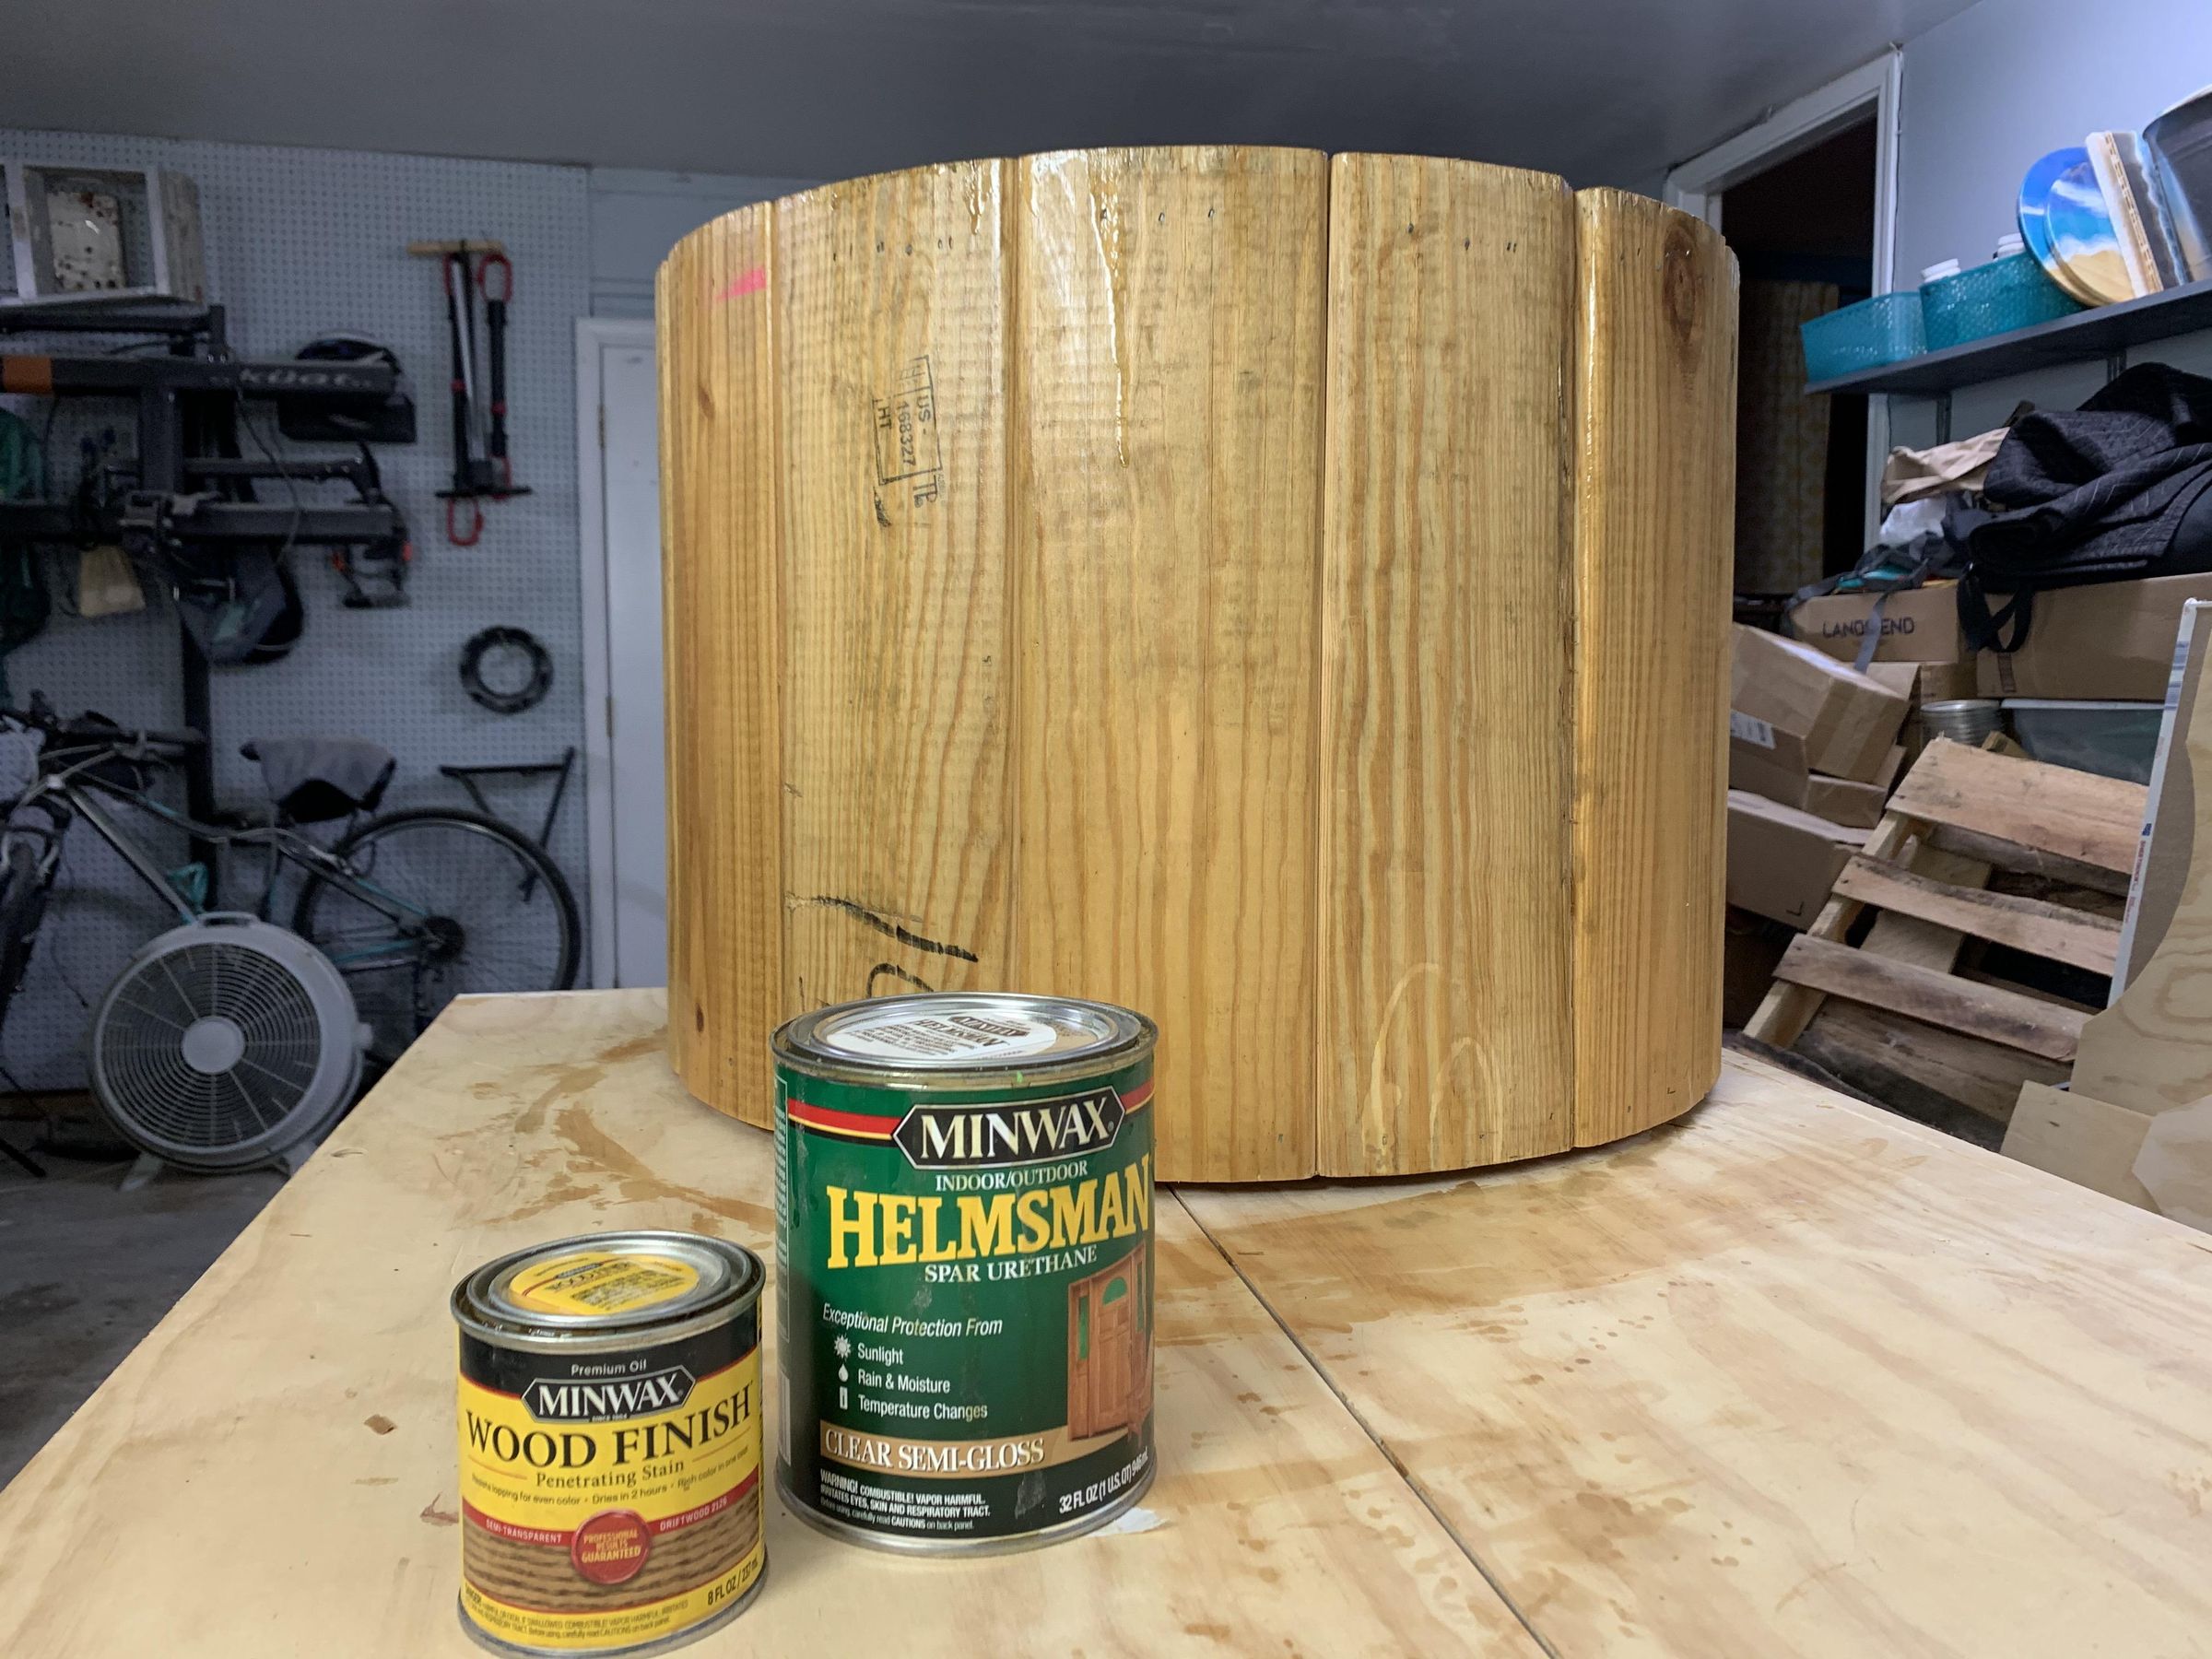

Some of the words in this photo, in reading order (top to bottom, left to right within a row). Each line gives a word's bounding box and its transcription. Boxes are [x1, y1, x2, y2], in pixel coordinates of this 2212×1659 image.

[877, 405, 893, 429] HT
[896, 400, 916, 466] 168327
[1822, 618, 1877, 639] LAND
[1880, 617, 1915, 635] END
[921, 1097, 1113, 1159] MINWAX
[935, 1160, 1088, 1192] INDOOR/OUTDOOR
[827, 1153, 1150, 1268] HELMSMAN
[924, 1261, 981, 1283] SPAR
[988, 1244, 1097, 1281] URETHANE
[823, 1303, 888, 1333] Exceptional
[891, 1316, 961, 1336] Protection
[966, 1318, 1003, 1335] From
[571, 1364, 625, 1376] Premium
[629, 1359, 647, 1372] Oil
[858, 1342, 903, 1366] Sunlight
[539, 1372, 680, 1416] MINWAX
[858, 1369, 882, 1388] Rain
[885, 1374, 894, 1390] &
[898, 1374, 950, 1394] Moisture
[858, 1394, 930, 1419] Temperature
[934, 1403, 988, 1422] Changes
[465, 1408, 596, 1469] WOOD
[612, 1386, 751, 1465] FINISH
[825, 1429, 893, 1468] CLEAR
[899, 1438, 1045, 1472] SEMI-GLOSS
[520, 1491, 531, 1502] for
[557, 1495, 581, 1505] color
[593, 1495, 618, 1504] Dries
[620, 1492, 629, 1500] in
[631, 1490, 639, 1500] 2
[640, 1484, 667, 1497] hours
[699, 1466, 717, 1480] color
[535, 1470, 636, 1488] Penetrating
[641, 1459, 684, 1480] Stain
[820, 1469, 858, 1494] WARNING!
[860, 1485, 914, 1504] COMBUSTIBLE!
[915, 1494, 942, 1505] VAPOR
[870, 1500, 888, 1512] SKIN
[888, 1503, 904, 1515] AND
[907, 1505, 960, 1518] RESPIRATORY
[1059, 1494, 1072, 1513] 32
[1086, 1483, 1099, 1504] OZ
[486, 1519, 562, 1543] SEMI-TRANSPARENT
[660, 1505, 710, 1532] DRIFTWOOD
[877, 1516, 890, 1525] read
[891, 1516, 925, 1529] CAUTIONS
[936, 1520, 953, 1530] back
[584, 1526, 638, 1544] PROFESSIONAL
[582, 1545, 641, 1563] GUARANTEED
[707, 1592, 714, 1606] 8
[715, 1587, 724, 1602] FL
[726, 1575, 736, 1593] OZ
